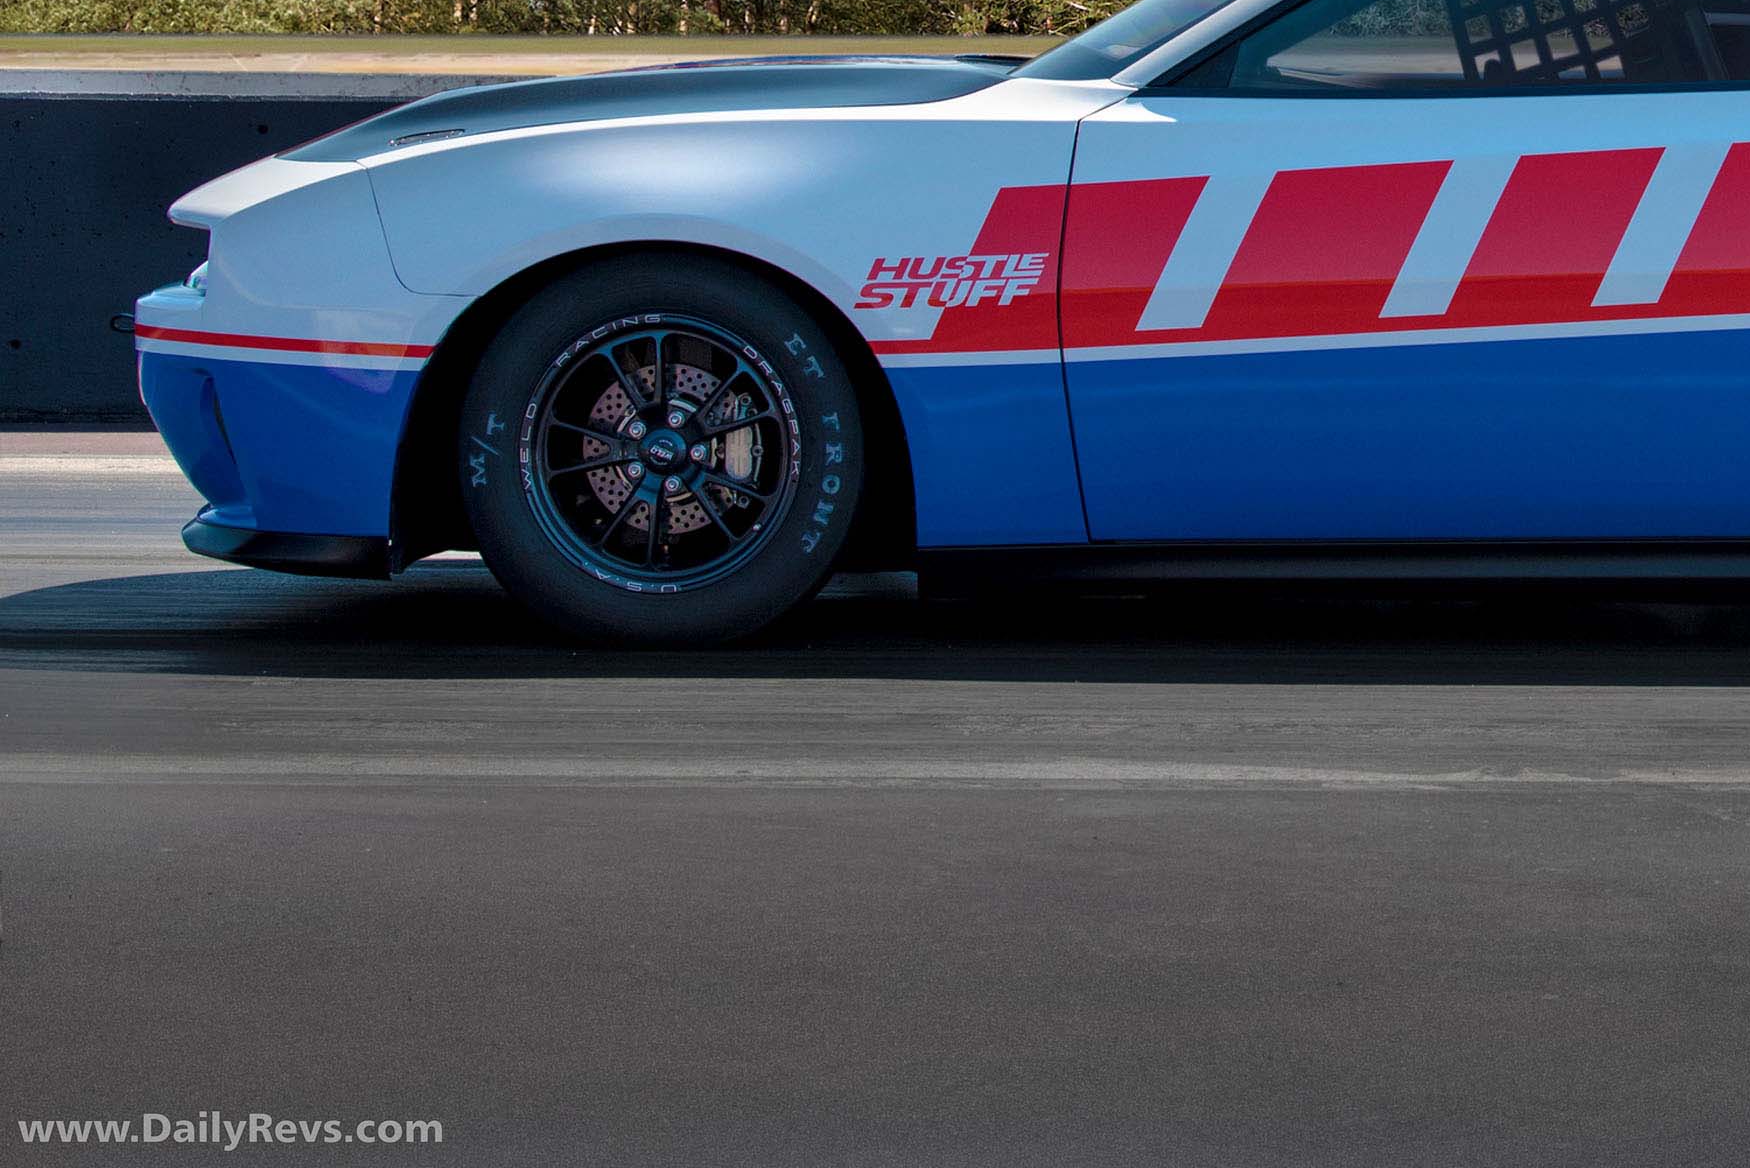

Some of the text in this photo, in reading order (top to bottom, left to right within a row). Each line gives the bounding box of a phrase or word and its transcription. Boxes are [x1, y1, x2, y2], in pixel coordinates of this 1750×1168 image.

[853, 278, 1039, 309] STUFF
[867, 253, 1049, 281] HUSTLE
[470, 413, 505, 488] M/T
[519, 314, 661, 490] WELD RACING
[743, 345, 800, 475] DRAGPAK
[784, 333, 844, 553] ET FRONT
